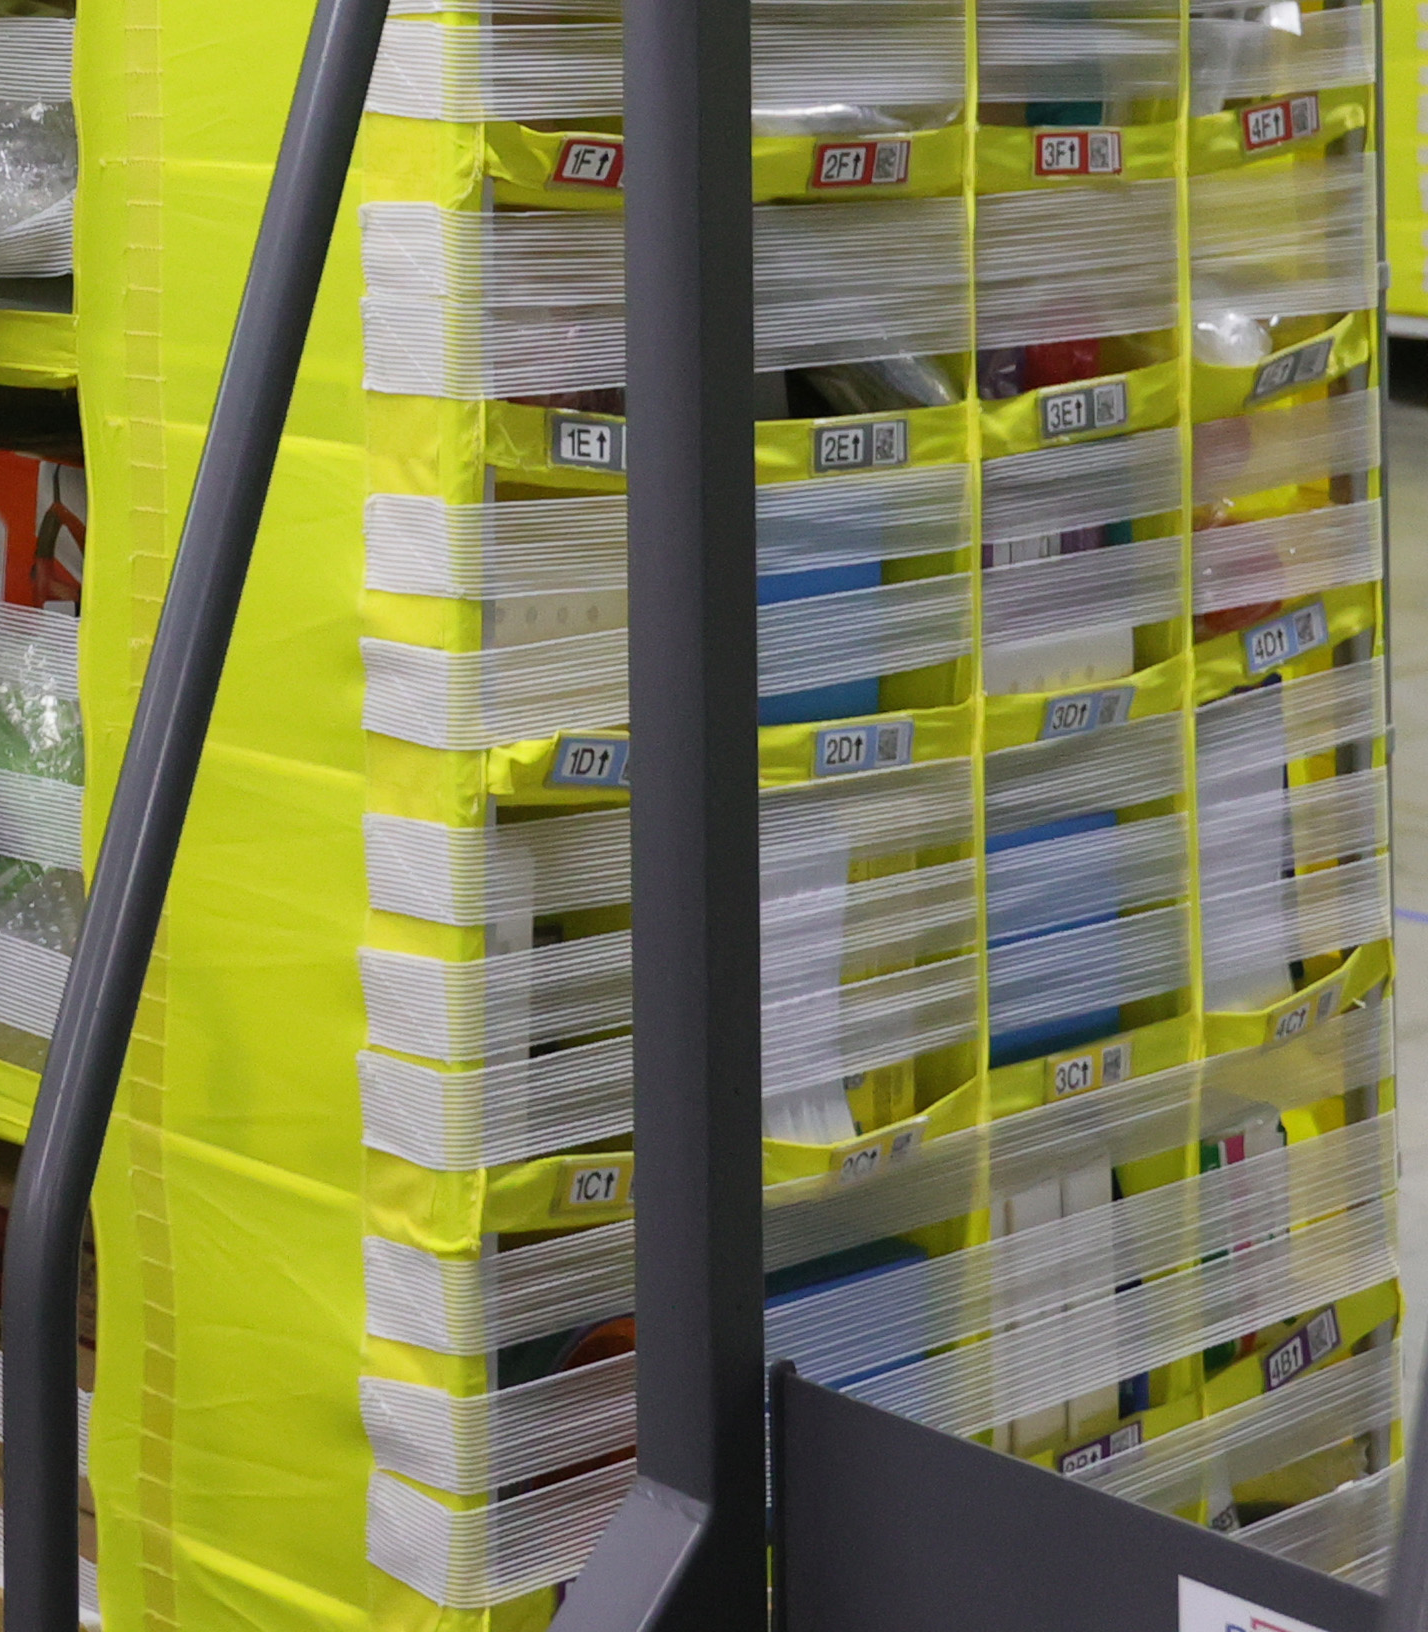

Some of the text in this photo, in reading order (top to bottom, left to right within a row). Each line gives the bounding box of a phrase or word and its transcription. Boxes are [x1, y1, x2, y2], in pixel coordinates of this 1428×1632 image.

[1251, 111, 1271, 139] 4F
[573, 148, 596, 176] 1F
[825, 150, 851, 179] 2F
[1044, 141, 1066, 167] 3F
[1050, 400, 1073, 429] 3E
[568, 429, 591, 458] 1E
[824, 435, 850, 462] 2E
[1255, 631, 1276, 660] 4D
[1052, 702, 1077, 730] 3D
[572, 747, 596, 775] 1D
[826, 737, 852, 765] 2D
[1275, 1015, 1295, 1039] 4C
[1056, 1064, 1082, 1095] 3C
[576, 1171, 603, 1200] 1C
[1270, 1347, 1292, 1381] 4B
